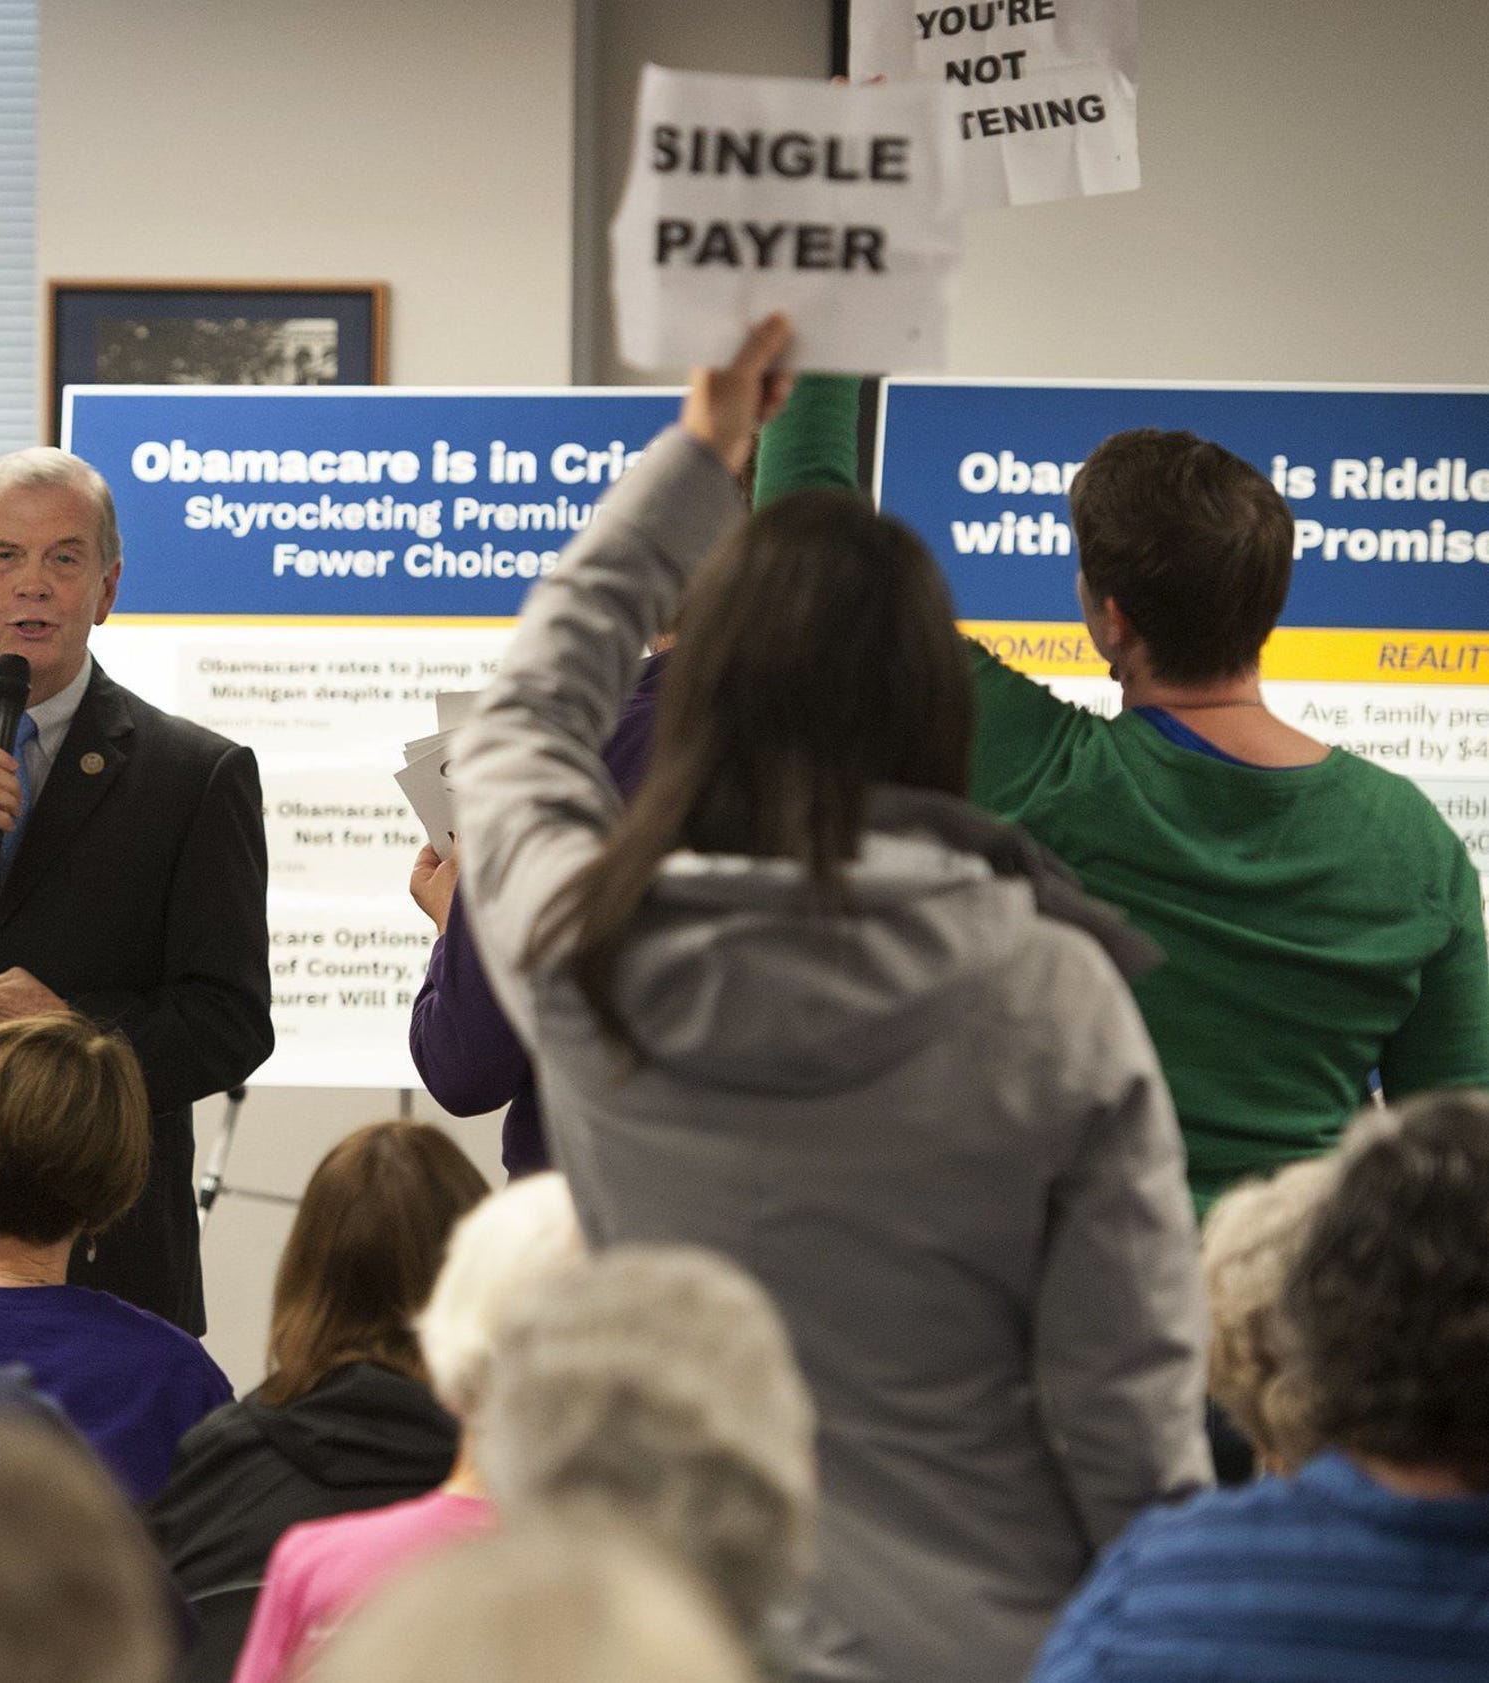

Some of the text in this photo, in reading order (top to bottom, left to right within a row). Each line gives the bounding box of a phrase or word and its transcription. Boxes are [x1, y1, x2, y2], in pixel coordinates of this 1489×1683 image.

[916, 0, 1056, 39] YOU'RE
[945, 50, 1027, 87] NOT
[653, 124, 910, 183] SINGLE
[654, 218, 887, 272] PAYER
[131, 438, 420, 484] Obamacare
[431, 440, 477, 484] is
[490, 440, 537, 484] in
[1272, 455, 1317, 499] is
[184, 495, 443, 537] Skyrocketing
[950, 511, 1071, 556] with
[273, 543, 394, 577] Fewer
[198, 656, 318, 675] Obamacare
[327, 656, 381, 675] rates
[390, 658, 411, 675] to
[416, 658, 471, 678] jump
[1378, 643, 1489, 671] REALIT
[211, 683, 308, 703] Michigan
[1364, 703, 1440, 729] family
[1420, 740, 1449, 762] by
[278, 802, 407, 817] Obamacare
[295, 829, 419, 845] Not for the
[335, 929, 431, 950] Options
[274, 958, 297, 976] of
[339, 990, 385, 1006] Will
